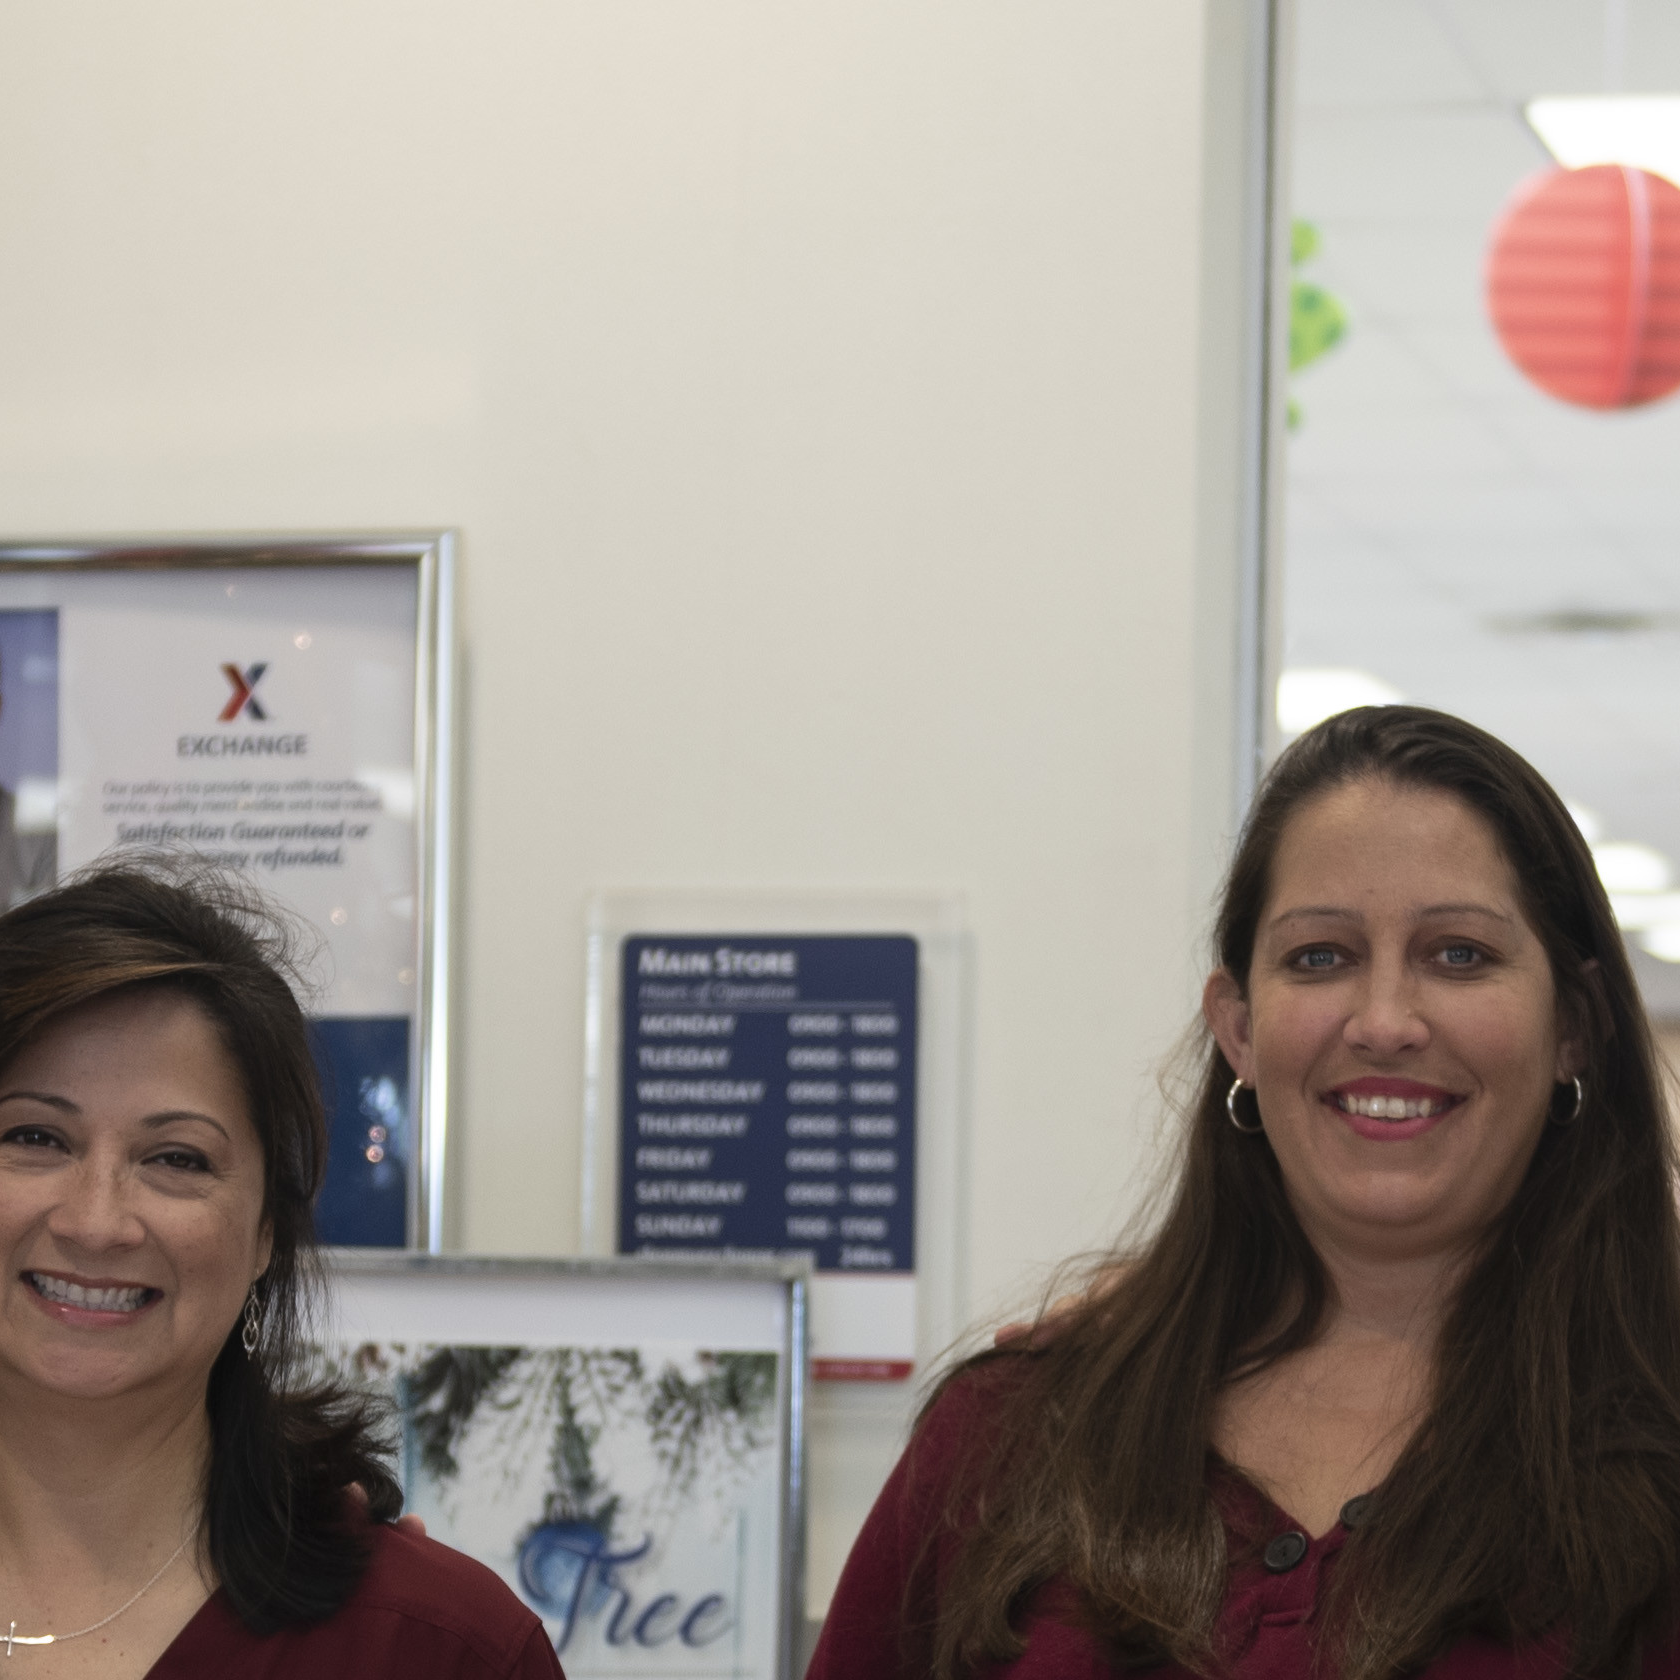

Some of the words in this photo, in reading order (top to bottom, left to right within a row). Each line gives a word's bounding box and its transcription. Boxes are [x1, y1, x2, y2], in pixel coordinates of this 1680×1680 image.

[176, 733, 309, 758] EXCHANGE
[117, 820, 225, 846] Satisfaction
[231, 819, 345, 841] Guaranteed
[348, 823, 371, 839] or
[639, 1014, 736, 1036] MONDAY
[638, 1046, 731, 1070] TUESDAY
[636, 1080, 765, 1104] WEDNESDAY
[637, 1113, 749, 1137] THURSDAY
[635, 1146, 713, 1171] FRIDAY
[635, 1180, 747, 1205] SATURDAY
[635, 1213, 723, 1239] SUNDAY
[520, 1531, 735, 1656] Tree
